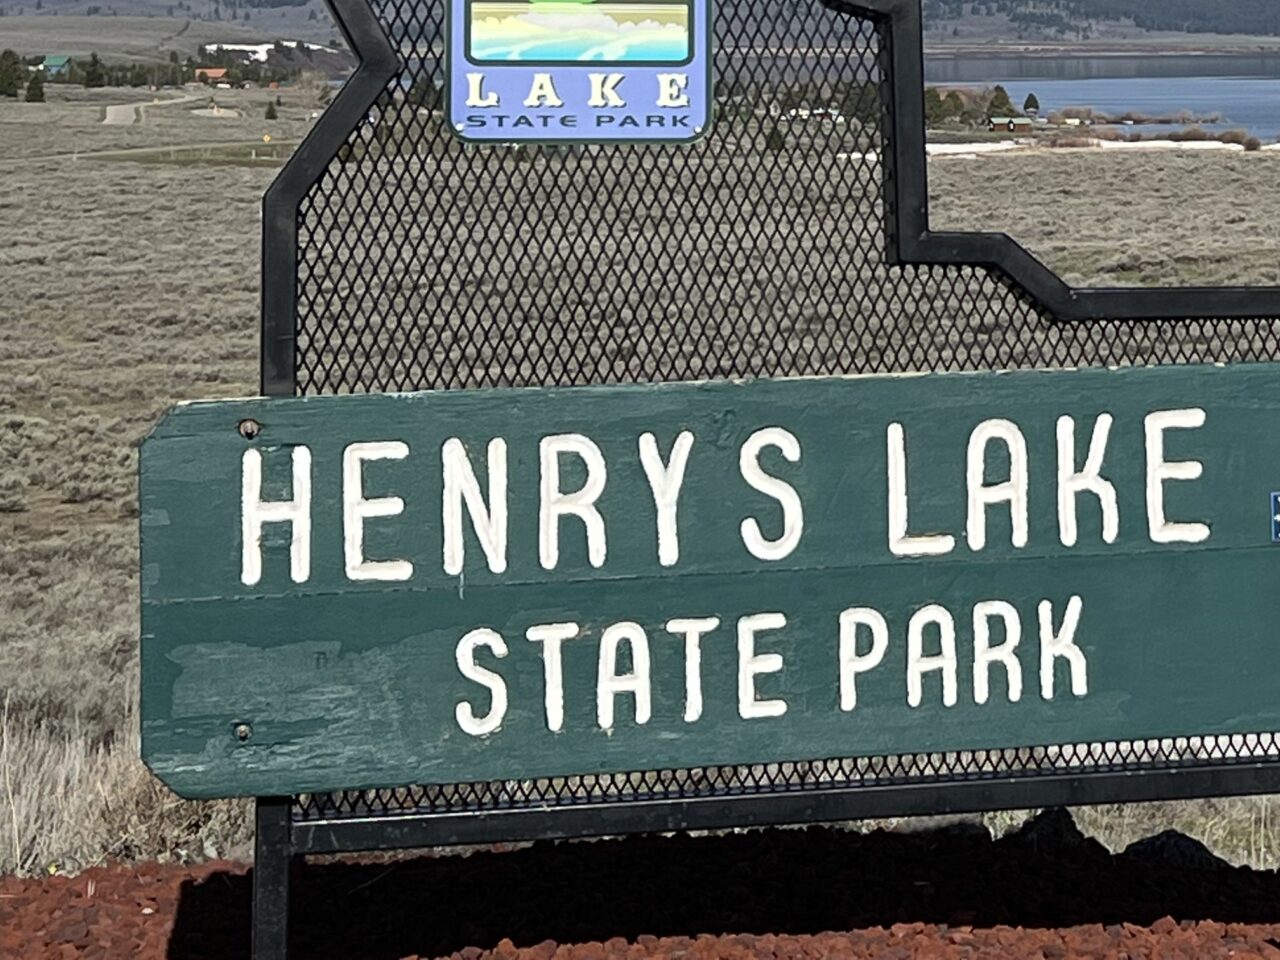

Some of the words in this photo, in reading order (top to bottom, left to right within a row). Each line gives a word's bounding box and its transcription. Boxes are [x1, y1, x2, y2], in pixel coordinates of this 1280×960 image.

[465, 72, 690, 109] LAKE
[466, 114, 578, 128] STATE
[595, 114, 692, 129] PARK
[242, 428, 803, 585] HENRYS
[888, 409, 1209, 555] LAKE
[456, 614, 787, 736] STATE
[840, 596, 1087, 711] PARK
